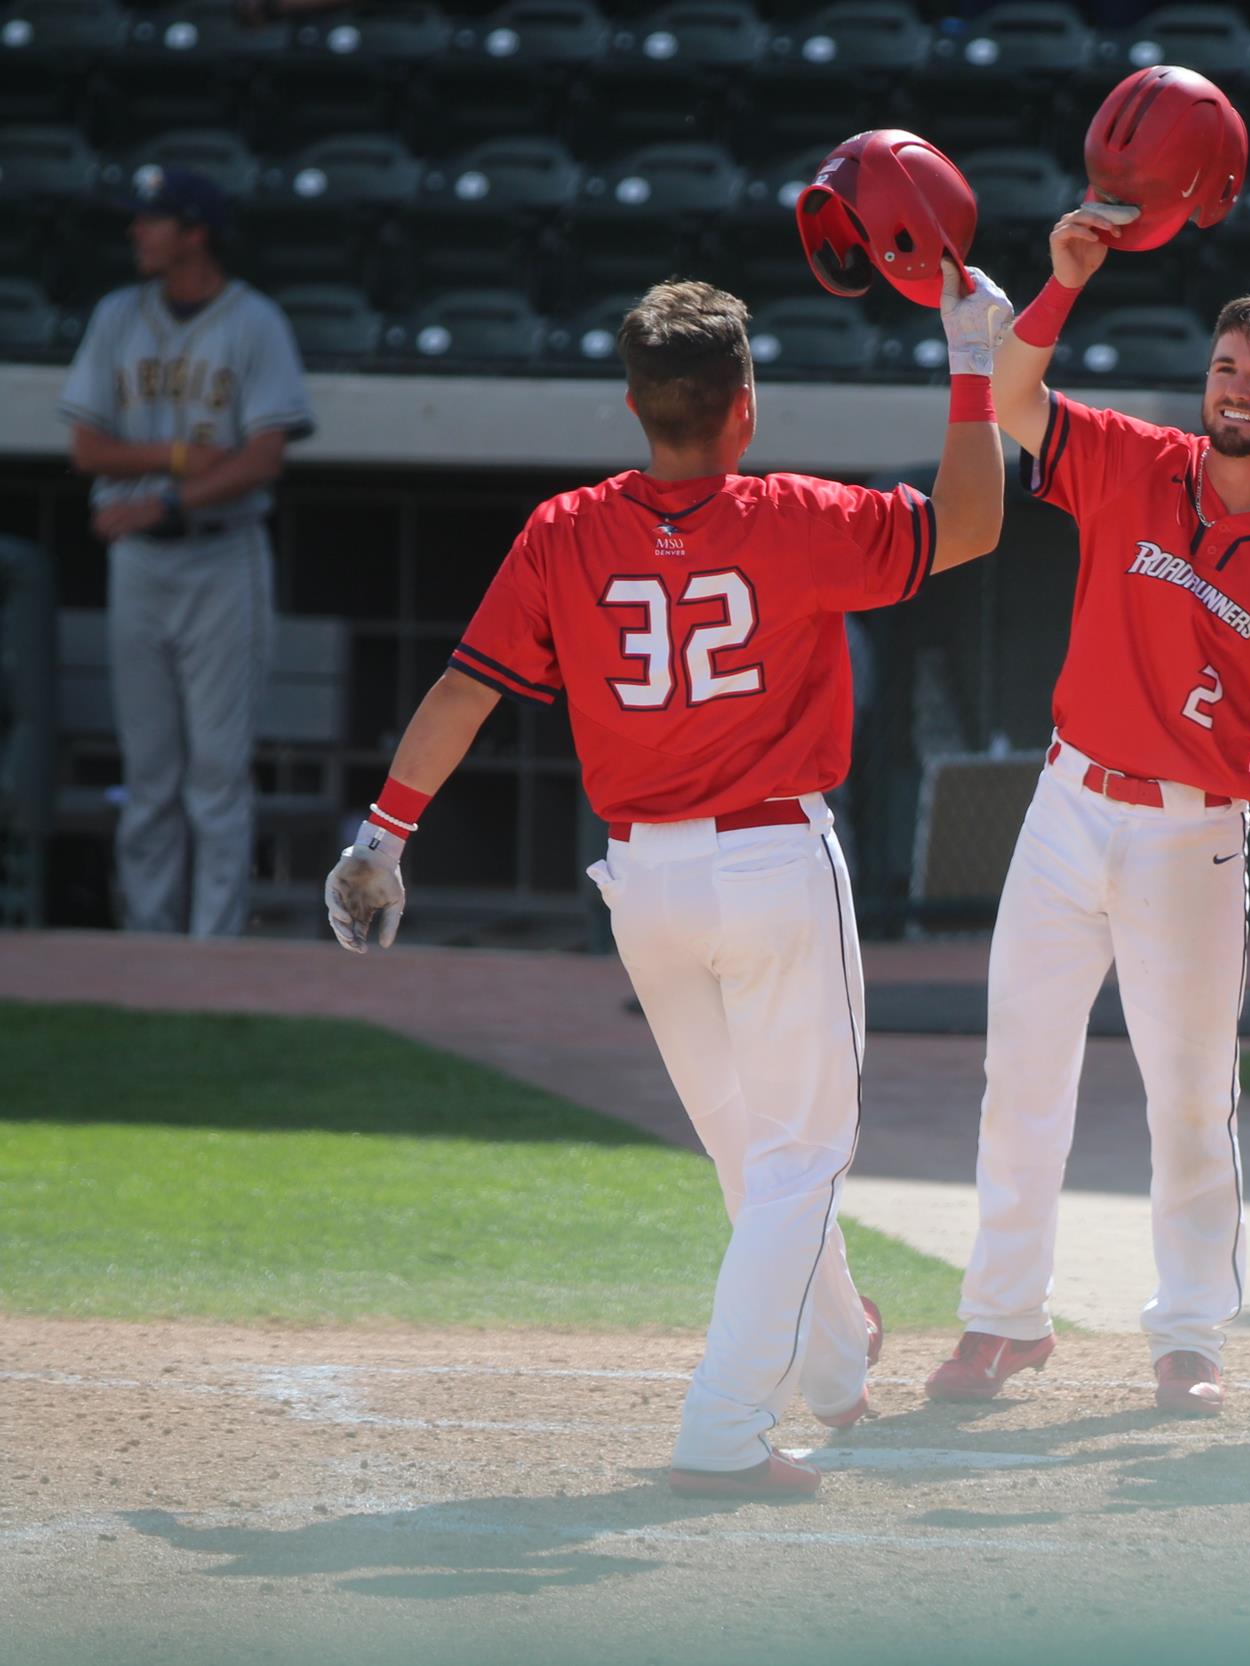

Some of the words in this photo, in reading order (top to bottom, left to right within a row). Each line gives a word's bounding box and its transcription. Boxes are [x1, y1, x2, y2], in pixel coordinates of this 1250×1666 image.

[656, 538, 684, 549] MSU
[597, 566, 766, 711] 32
[1181, 662, 1224, 730] 2
